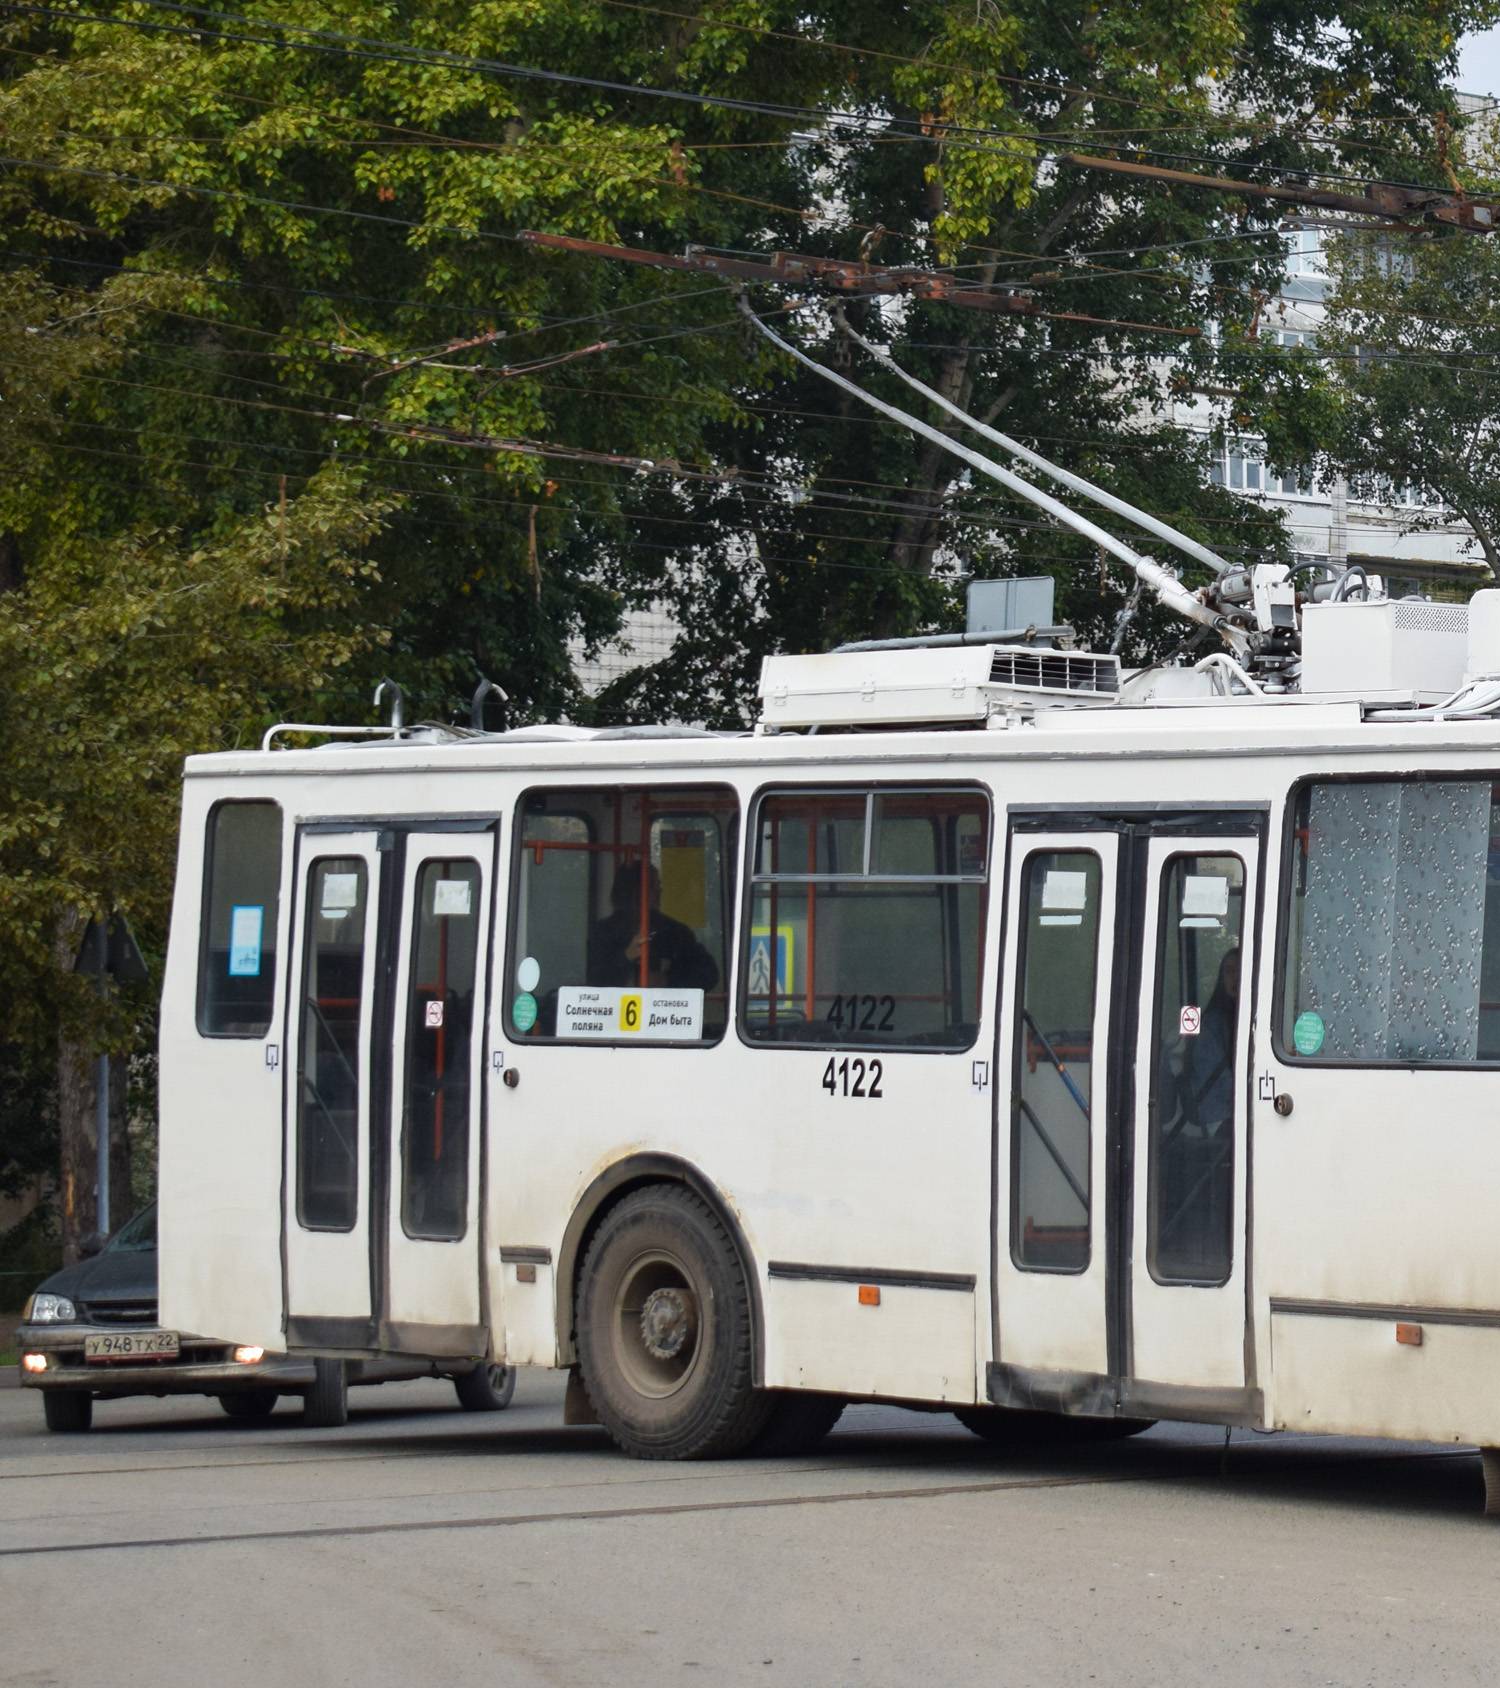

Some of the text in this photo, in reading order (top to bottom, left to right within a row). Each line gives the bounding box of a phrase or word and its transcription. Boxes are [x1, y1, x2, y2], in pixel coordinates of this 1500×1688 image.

[579, 993, 600, 1002] улица
[653, 999, 689, 1008] остановка
[566, 1004, 613, 1016] Солнечная
[625, 1000, 637, 1026] 6
[826, 994, 896, 1031] 4122
[572, 1020, 604, 1031] поляна
[649, 1013, 692, 1026] Дом быта
[822, 1056, 883, 1098] 4122
